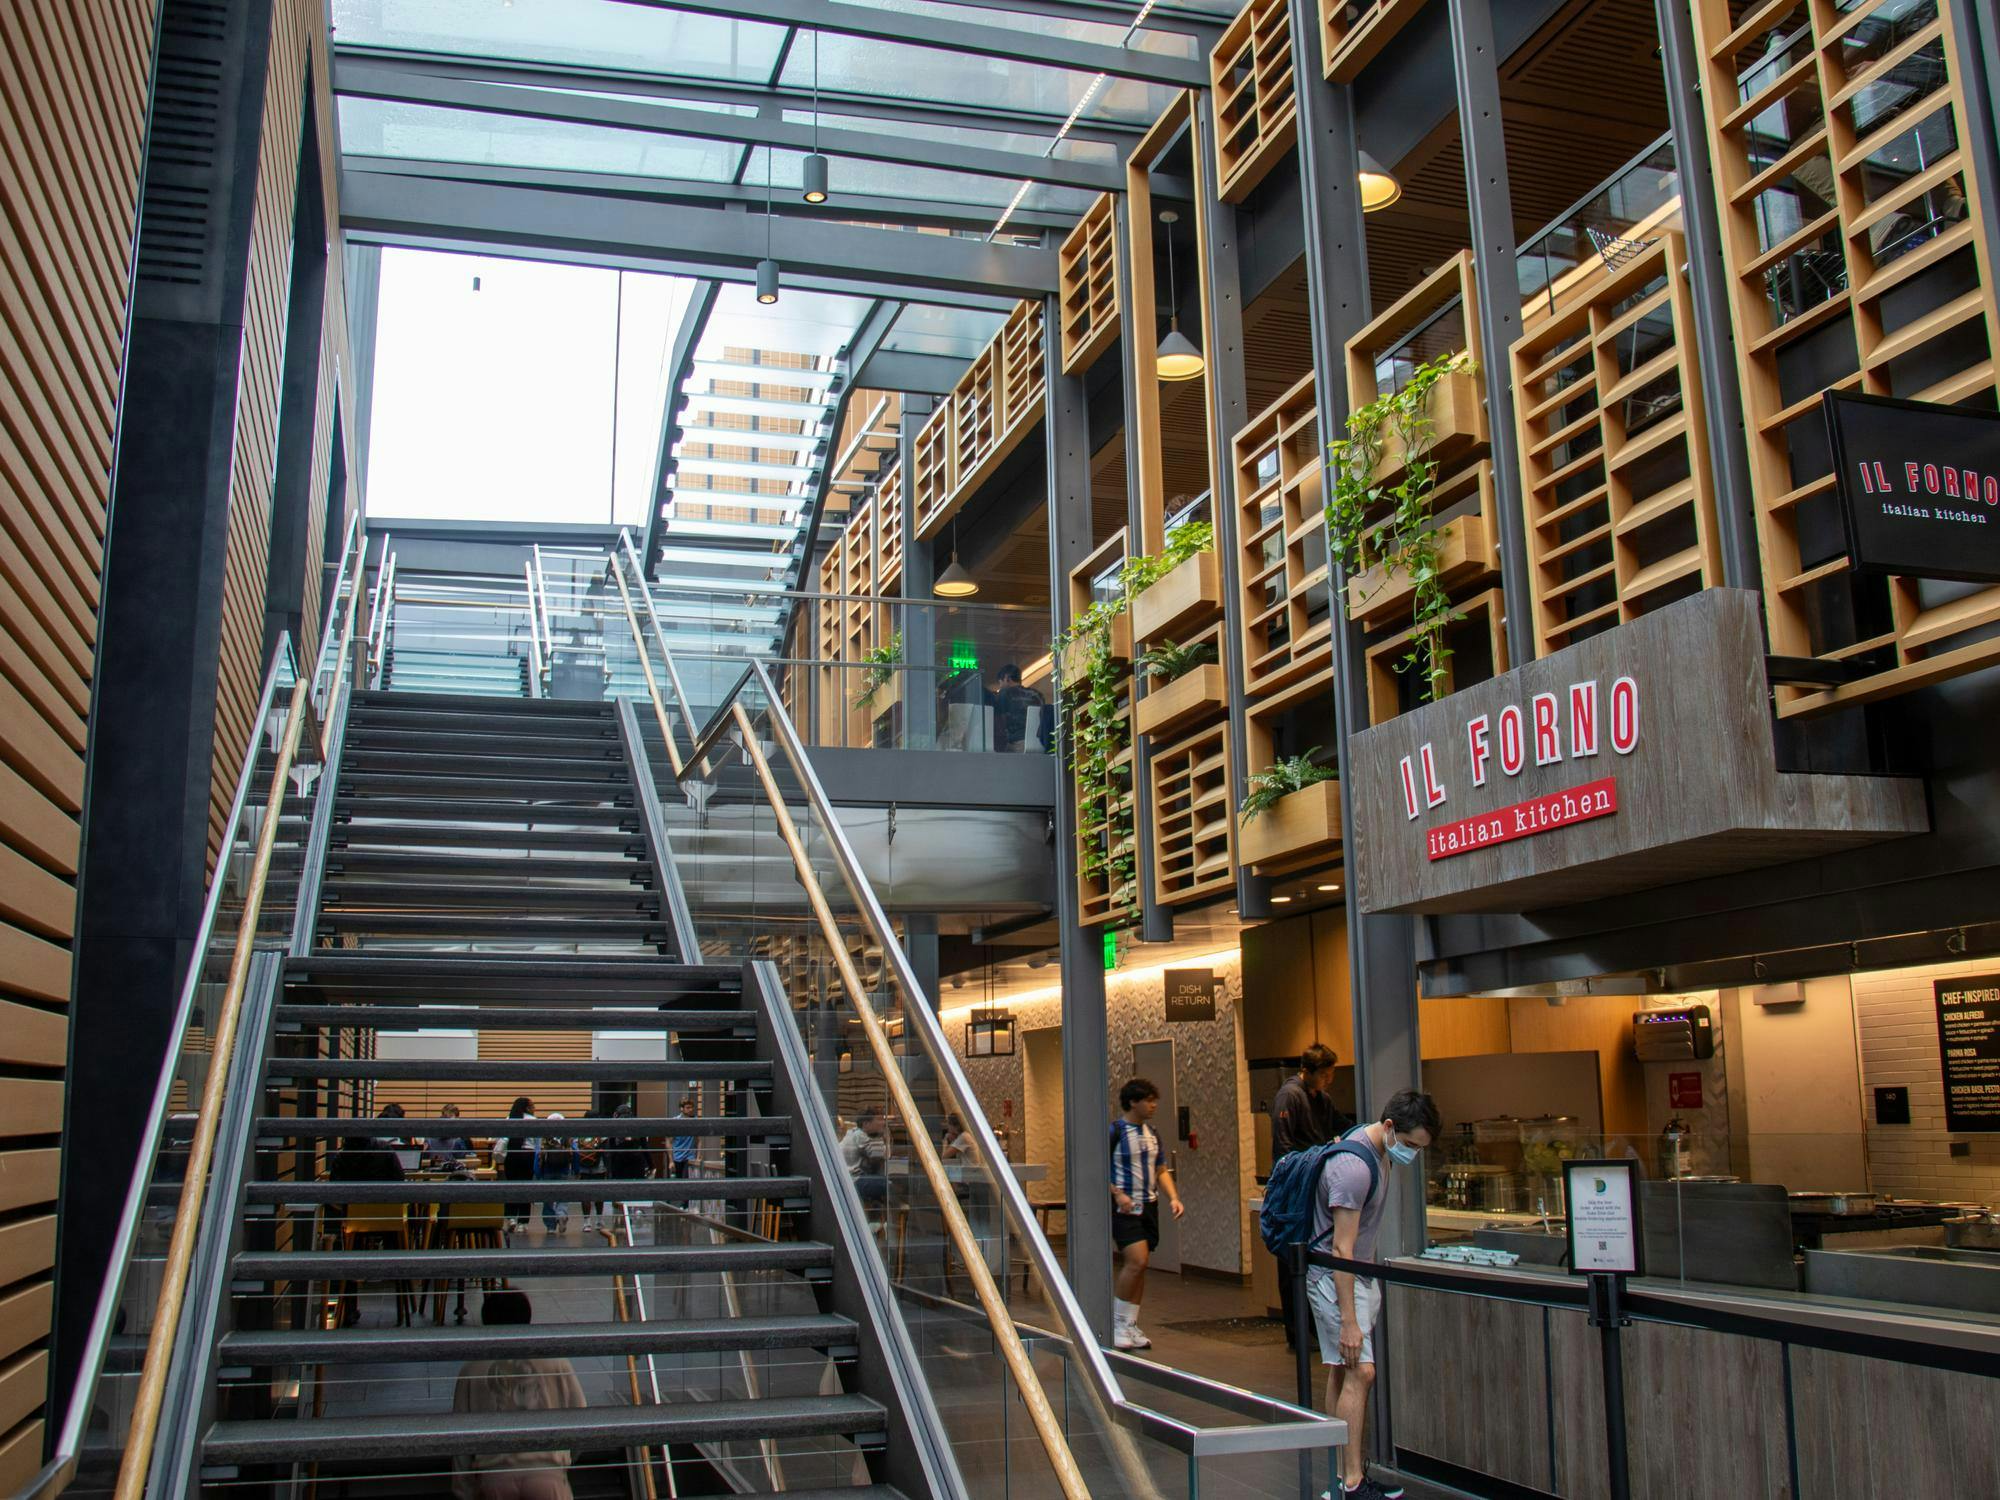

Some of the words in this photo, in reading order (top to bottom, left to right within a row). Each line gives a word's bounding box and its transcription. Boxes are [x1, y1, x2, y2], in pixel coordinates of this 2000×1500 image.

[1859, 462, 1892, 494] IL
[1905, 462, 1998, 505] FORNO
[1882, 503, 1930, 518] italian
[1935, 508, 1987, 524] kitchen
[1400, 742, 1447, 821] IL
[1467, 676, 1639, 788] FORNO
[1430, 819, 1504, 855] italian
[1514, 788, 1610, 833] kitchen
[1179, 984, 1202, 995] DISH
[1942, 988, 2000, 1005] CHEF-INSPIRED
[1171, 995, 1211, 1006] RETURN
